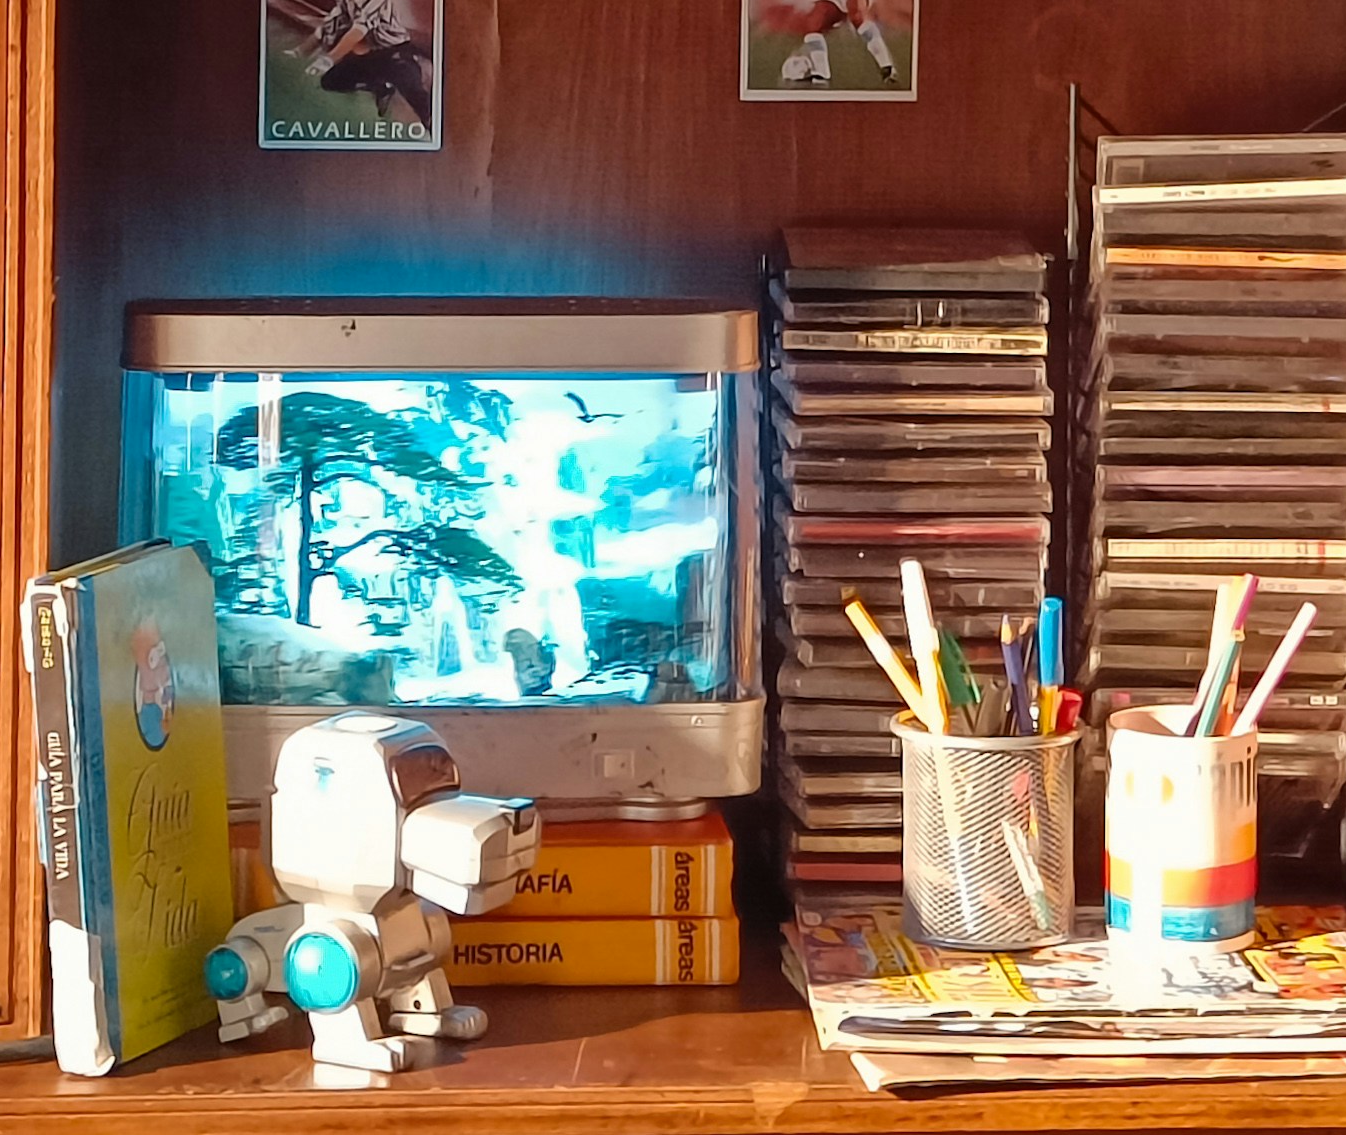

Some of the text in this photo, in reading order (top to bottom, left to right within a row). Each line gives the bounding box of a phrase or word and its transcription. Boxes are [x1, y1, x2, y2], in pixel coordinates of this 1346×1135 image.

[270, 120, 426, 139] CAVALLERO
[54, 841, 71, 881] VIDA
[673, 850, 696, 913] áreas
[453, 942, 564, 965] HISTORIA
[677, 919, 699, 982] áreas
